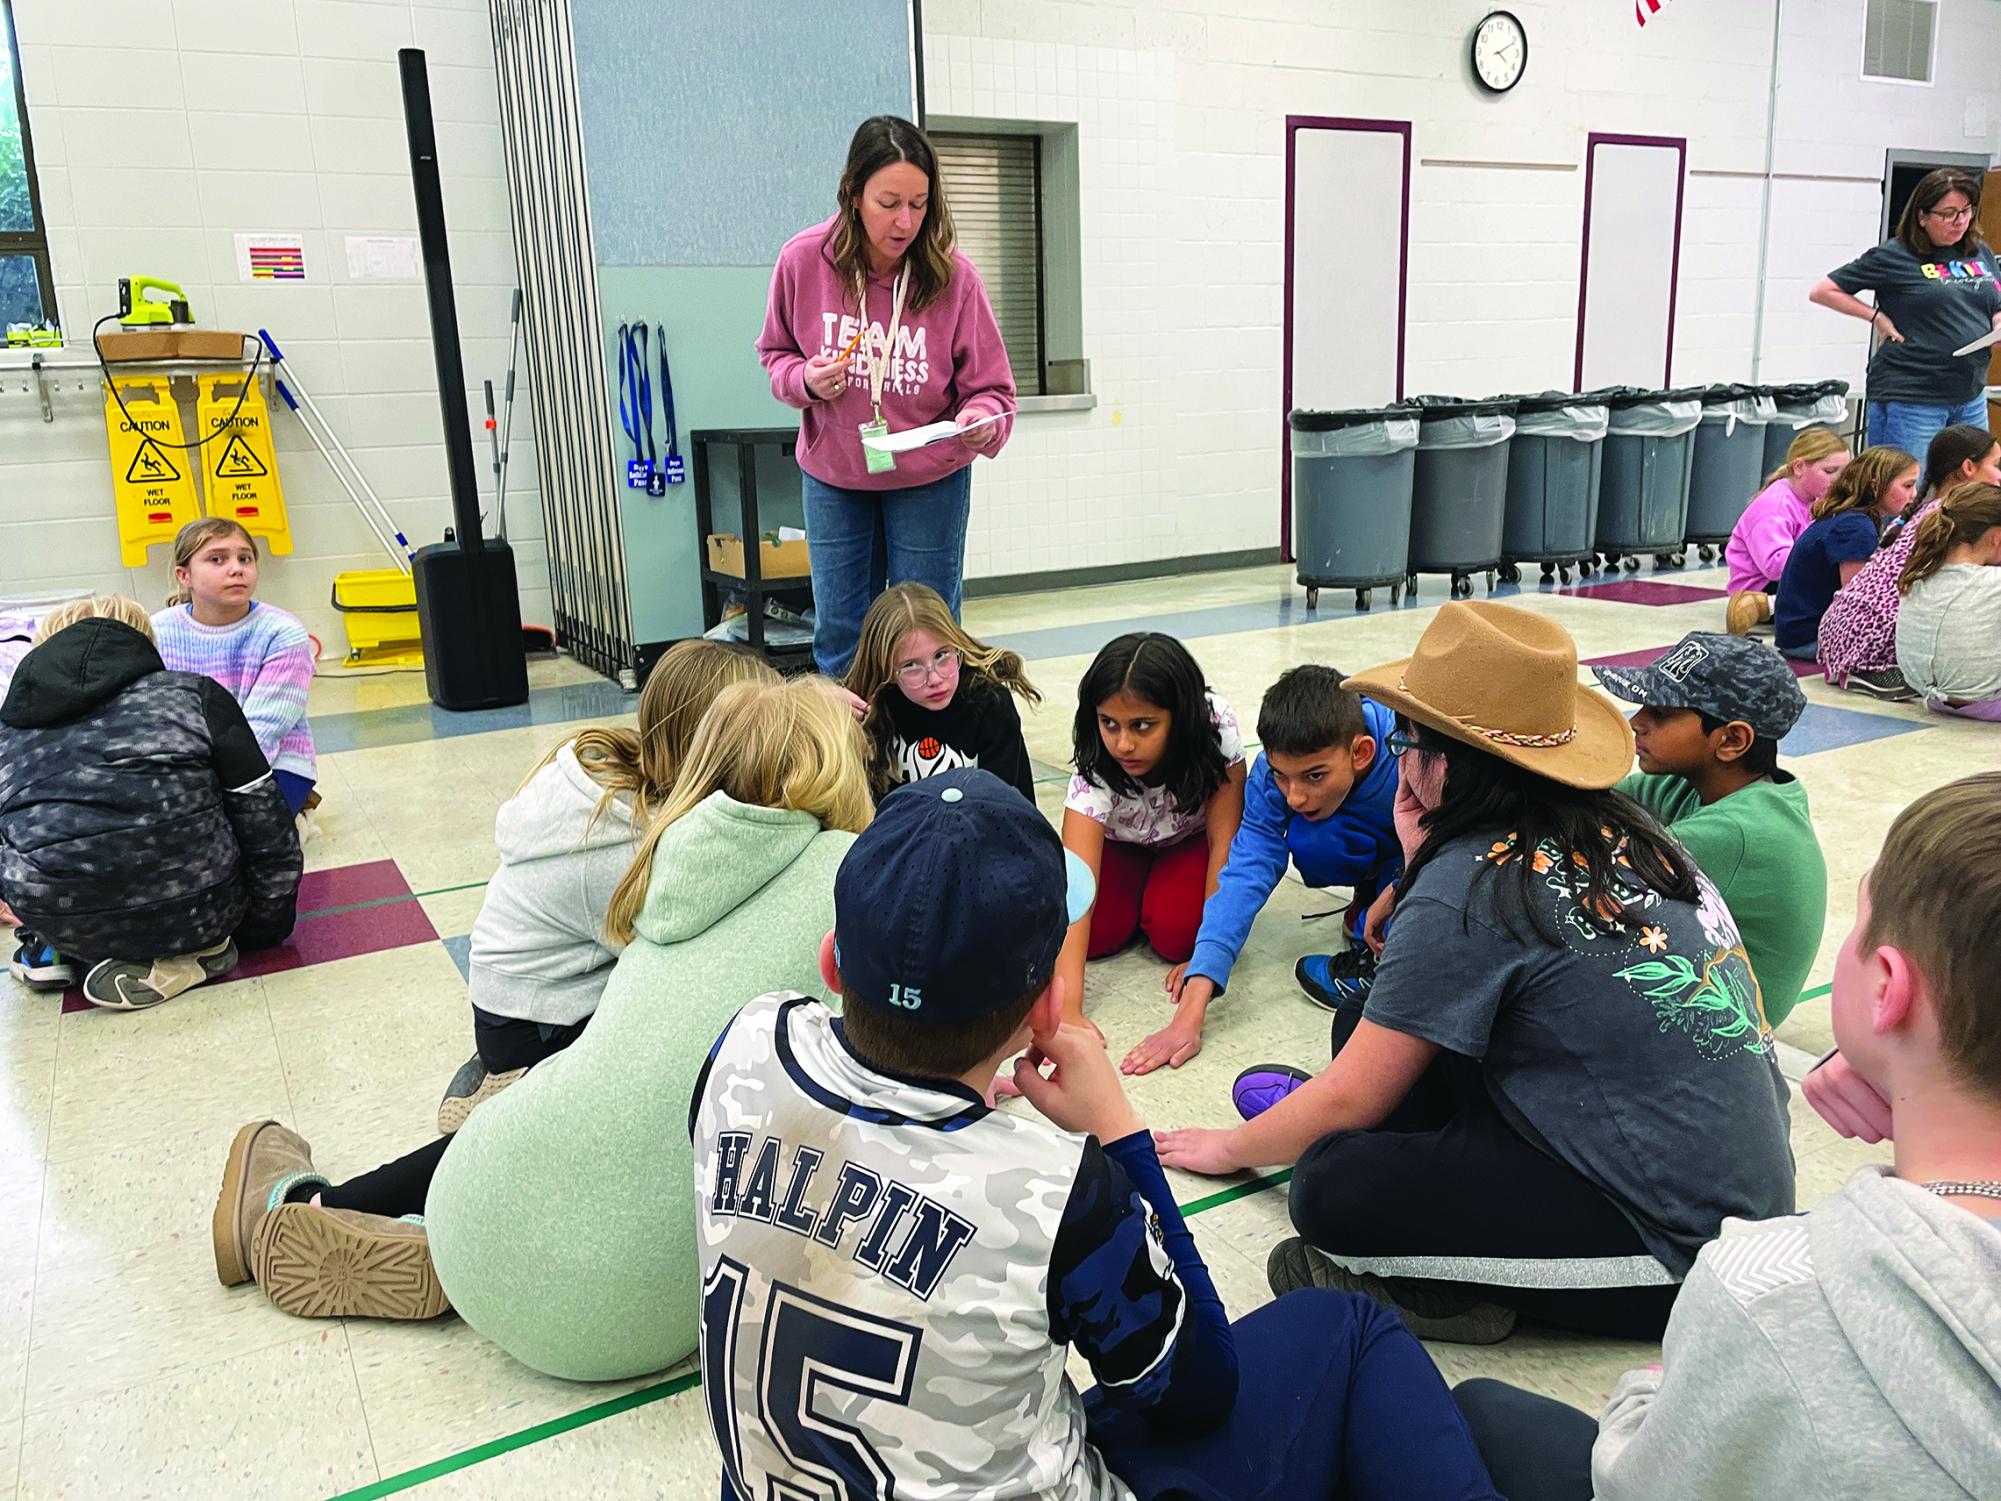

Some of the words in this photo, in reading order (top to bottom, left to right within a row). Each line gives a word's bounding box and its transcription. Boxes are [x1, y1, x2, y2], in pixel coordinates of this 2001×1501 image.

[822, 312, 927, 360] TEAM
[883, 381, 921, 396] HILS
[119, 420, 170, 432] CAUTION
[211, 416, 259, 428] CAUTION
[146, 488, 164, 496] WET
[235, 483, 251, 491] WET
[143, 497, 171, 506] FLOOR
[232, 492, 257, 501] FLOOR
[888, 983, 922, 1010] 15
[712, 1131, 978, 1302] HALPIN
[701, 1252, 924, 1501] 15
